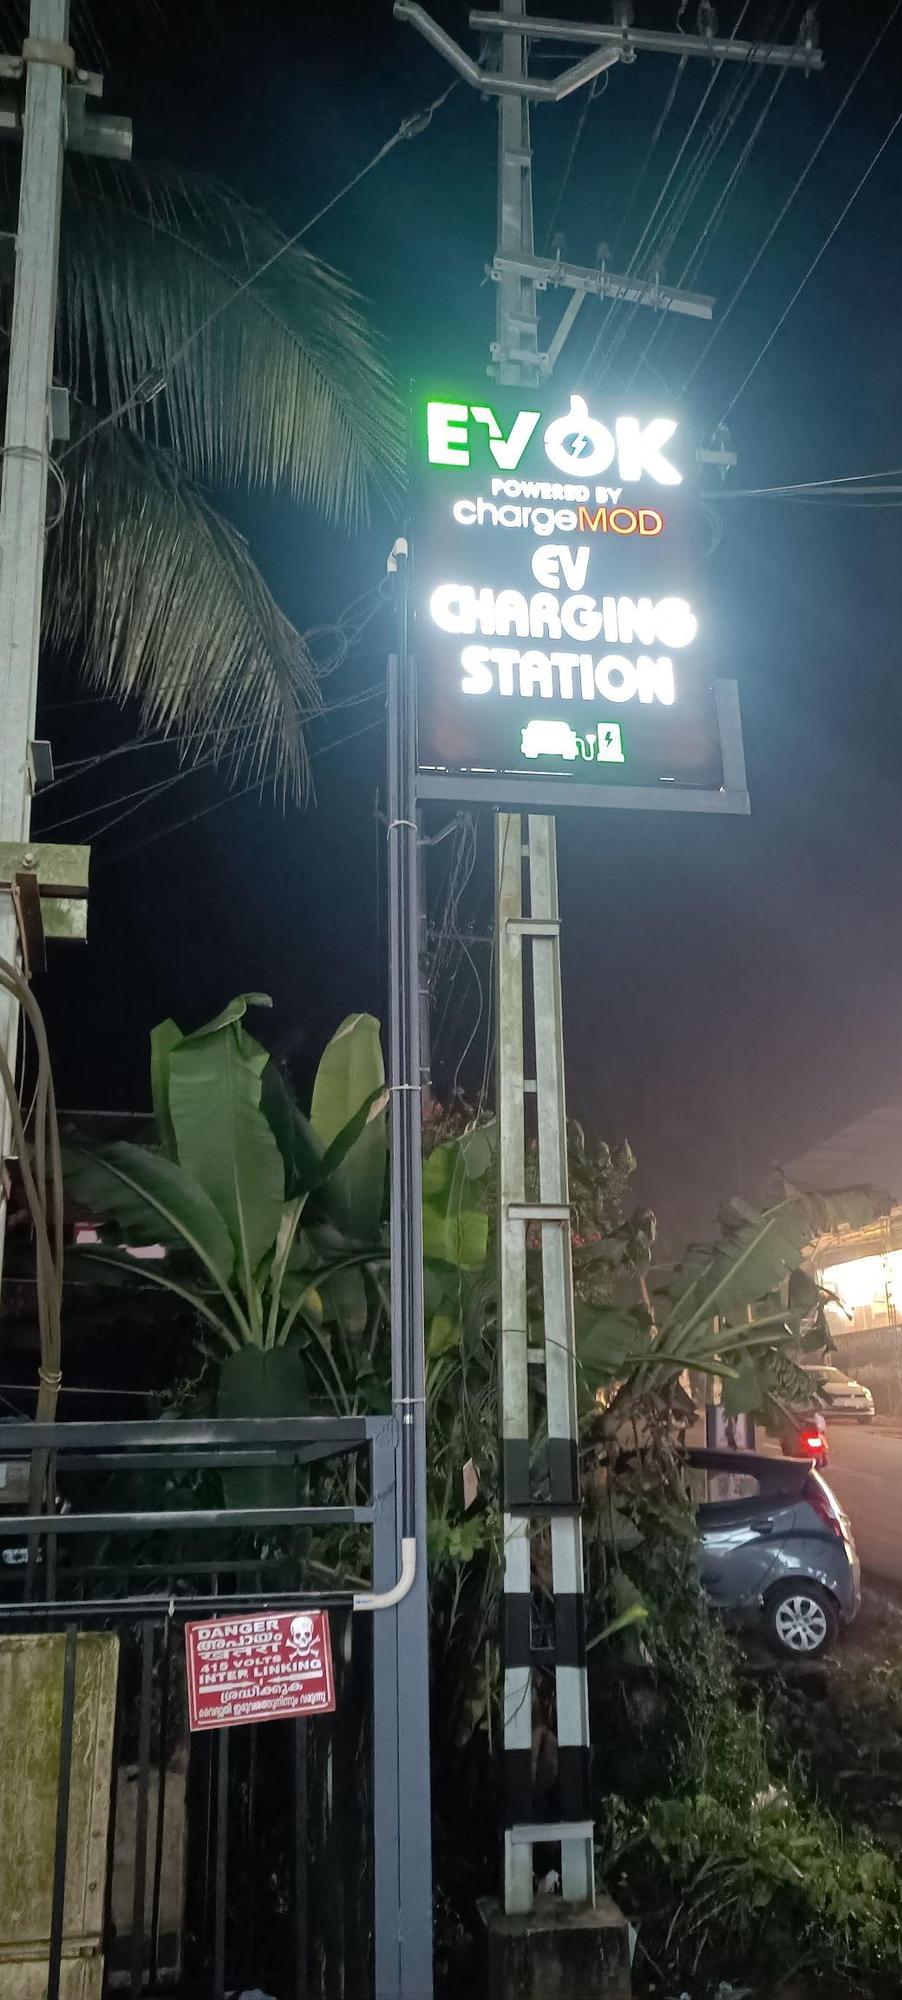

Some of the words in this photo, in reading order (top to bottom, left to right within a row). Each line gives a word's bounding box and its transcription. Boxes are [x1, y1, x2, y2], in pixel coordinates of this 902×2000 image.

[427, 394, 684, 485] EVOK
[491, 478, 590, 502] POWERED
[595, 485, 623, 505] BY
[453, 497, 663, 536] chargeMOD
[531, 544, 591, 591] EV
[429, 583, 698, 648] CHARGING
[460, 645, 676, 705] STATION
[197, 1632, 283, 1652] അപായം
[198, 1620, 279, 1640] DANGER
[198, 1642, 281, 1661] खतरा
[200, 1661, 229, 1673] 415
[234, 1655, 282, 1668] VOLTS
[199, 1669, 249, 1685] INTER
[253, 1659, 322, 1678] LINKING
